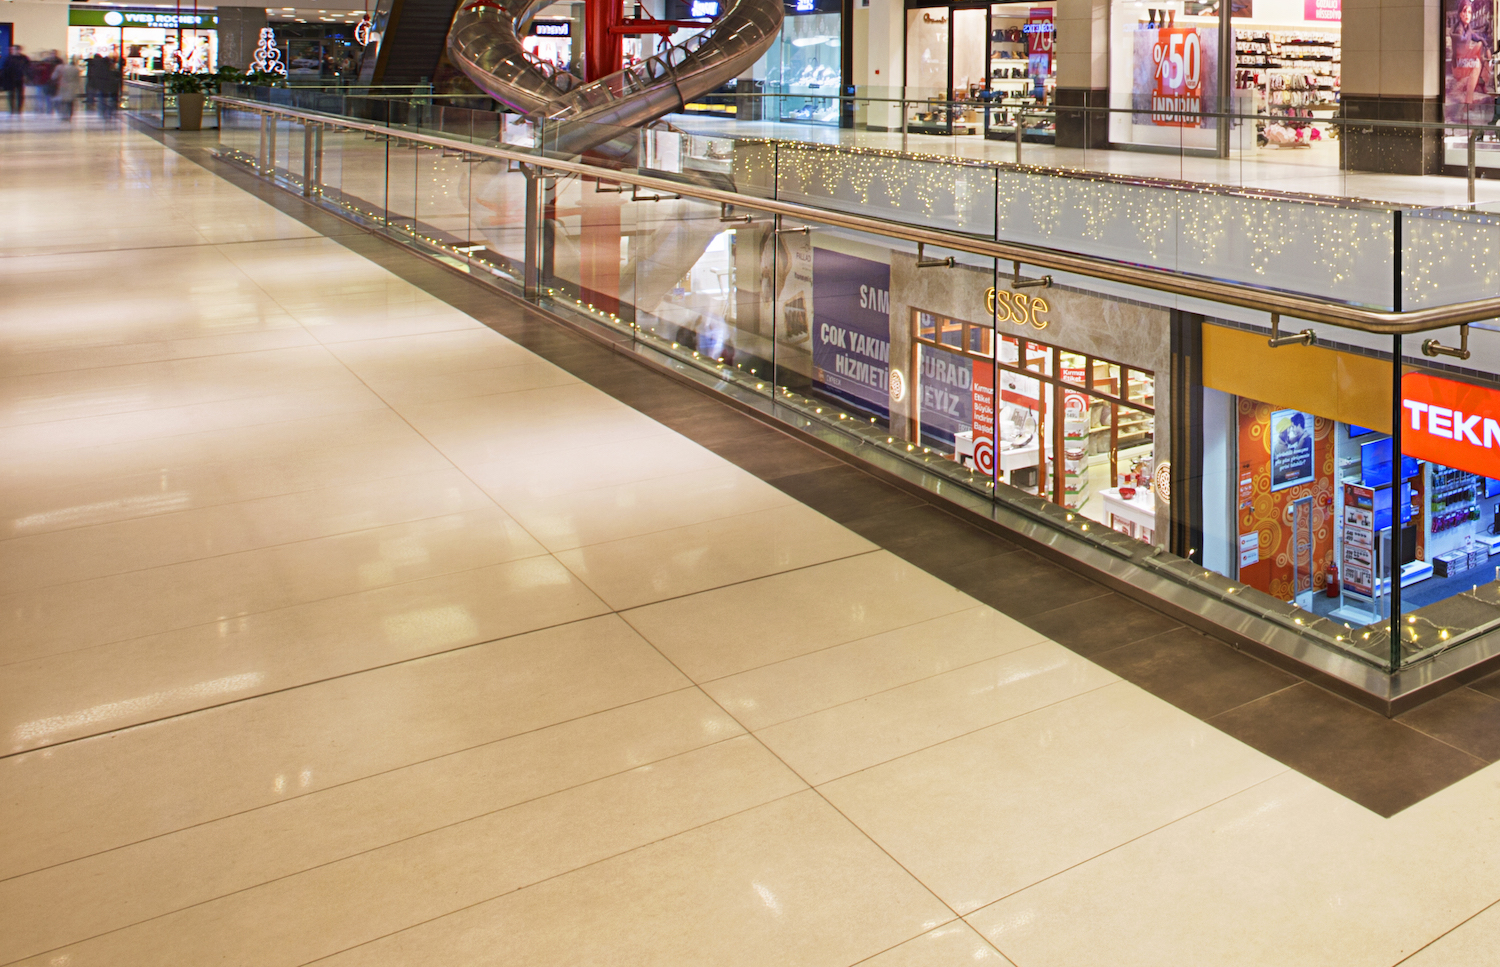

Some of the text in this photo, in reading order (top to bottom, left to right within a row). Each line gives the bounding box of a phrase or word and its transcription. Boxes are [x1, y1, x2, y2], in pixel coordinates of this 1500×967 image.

[537, 23, 569, 35] mavi
[1154, 33, 1200, 89] %50
[1153, 91, 1200, 123] İNDİRİM
[860, 284, 890, 315] SAM
[984, 286, 1048, 330] esse
[821, 323, 846, 349] ÇOK
[835, 353, 889, 391] HİZMETİ
[920, 385, 960, 416] EYİZ
[974, 383, 993, 394] Kırmız
[974, 393, 990, 404] Etiket
